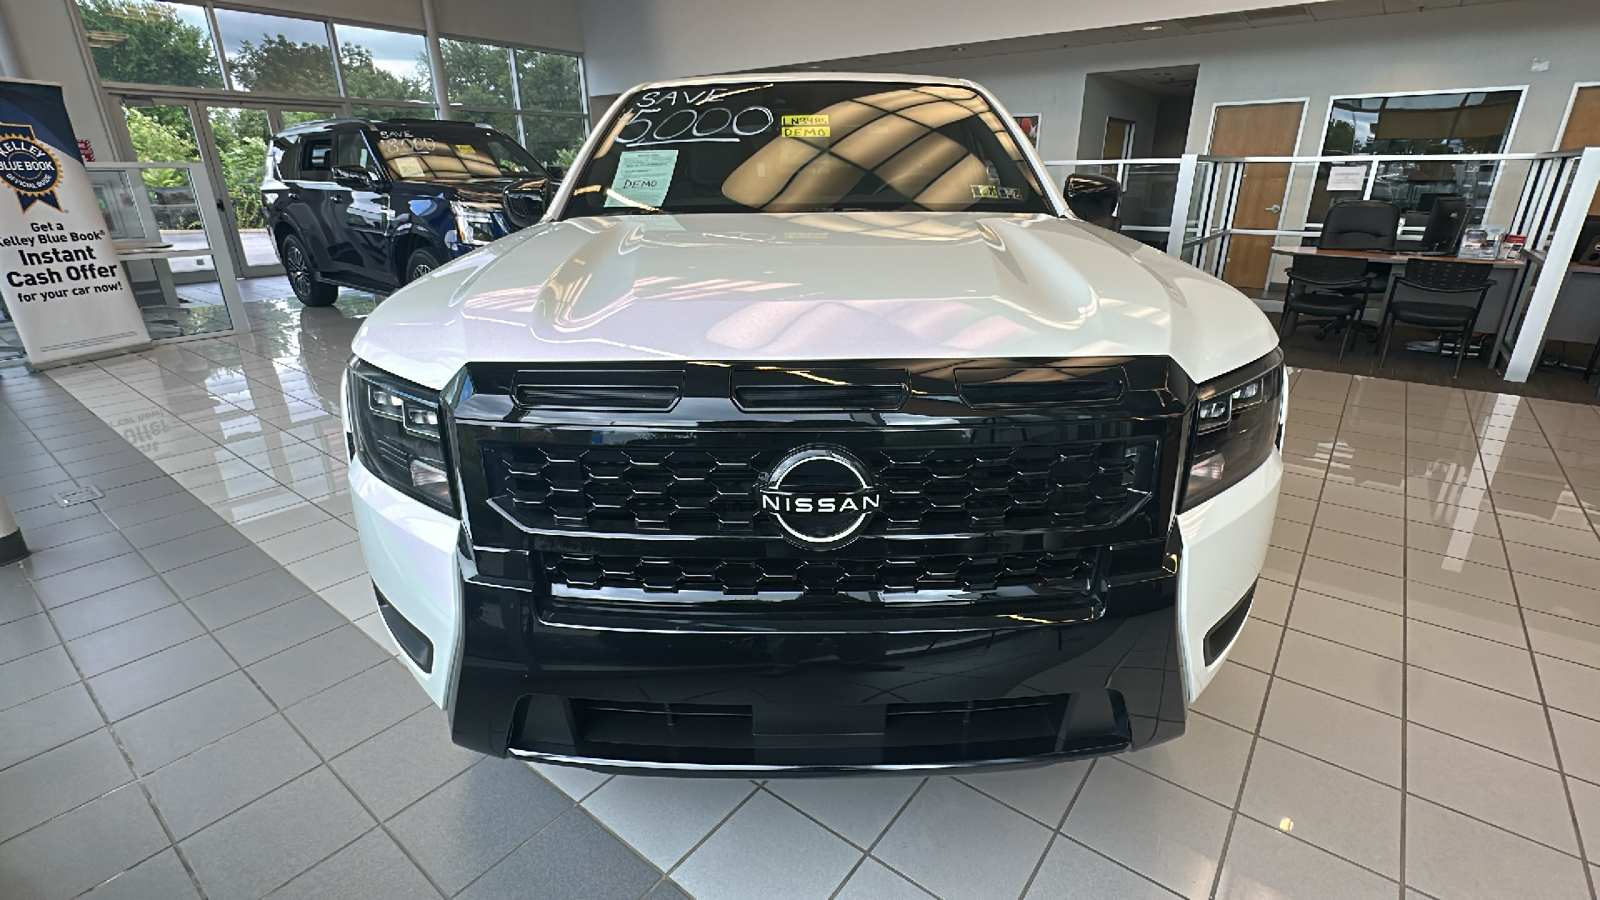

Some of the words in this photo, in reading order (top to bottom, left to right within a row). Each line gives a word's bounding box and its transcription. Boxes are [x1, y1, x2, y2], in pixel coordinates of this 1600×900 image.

[636, 88, 728, 107] SAVE
[380, 131, 414, 139] SAVE
[784, 128, 826, 137] DEMO
[0, 141, 46, 158] KELLEY
[24, 161, 55, 171] BOOK
[6, 173, 38, 189] OFFICIAL
[623, 179, 657, 189] DEMO
[30, 222, 54, 233] Get
[56, 222, 65, 231] a
[38, 233, 68, 244] Blue
[18, 245, 97, 266] Instant
[6, 267, 63, 288] Cash
[66, 263, 118, 281] Offer
[17, 292, 37, 303] for
[40, 288, 69, 302] your
[71, 286, 91, 296] car
[93, 281, 123, 293] now!
[762, 494, 880, 513] NISSAN
